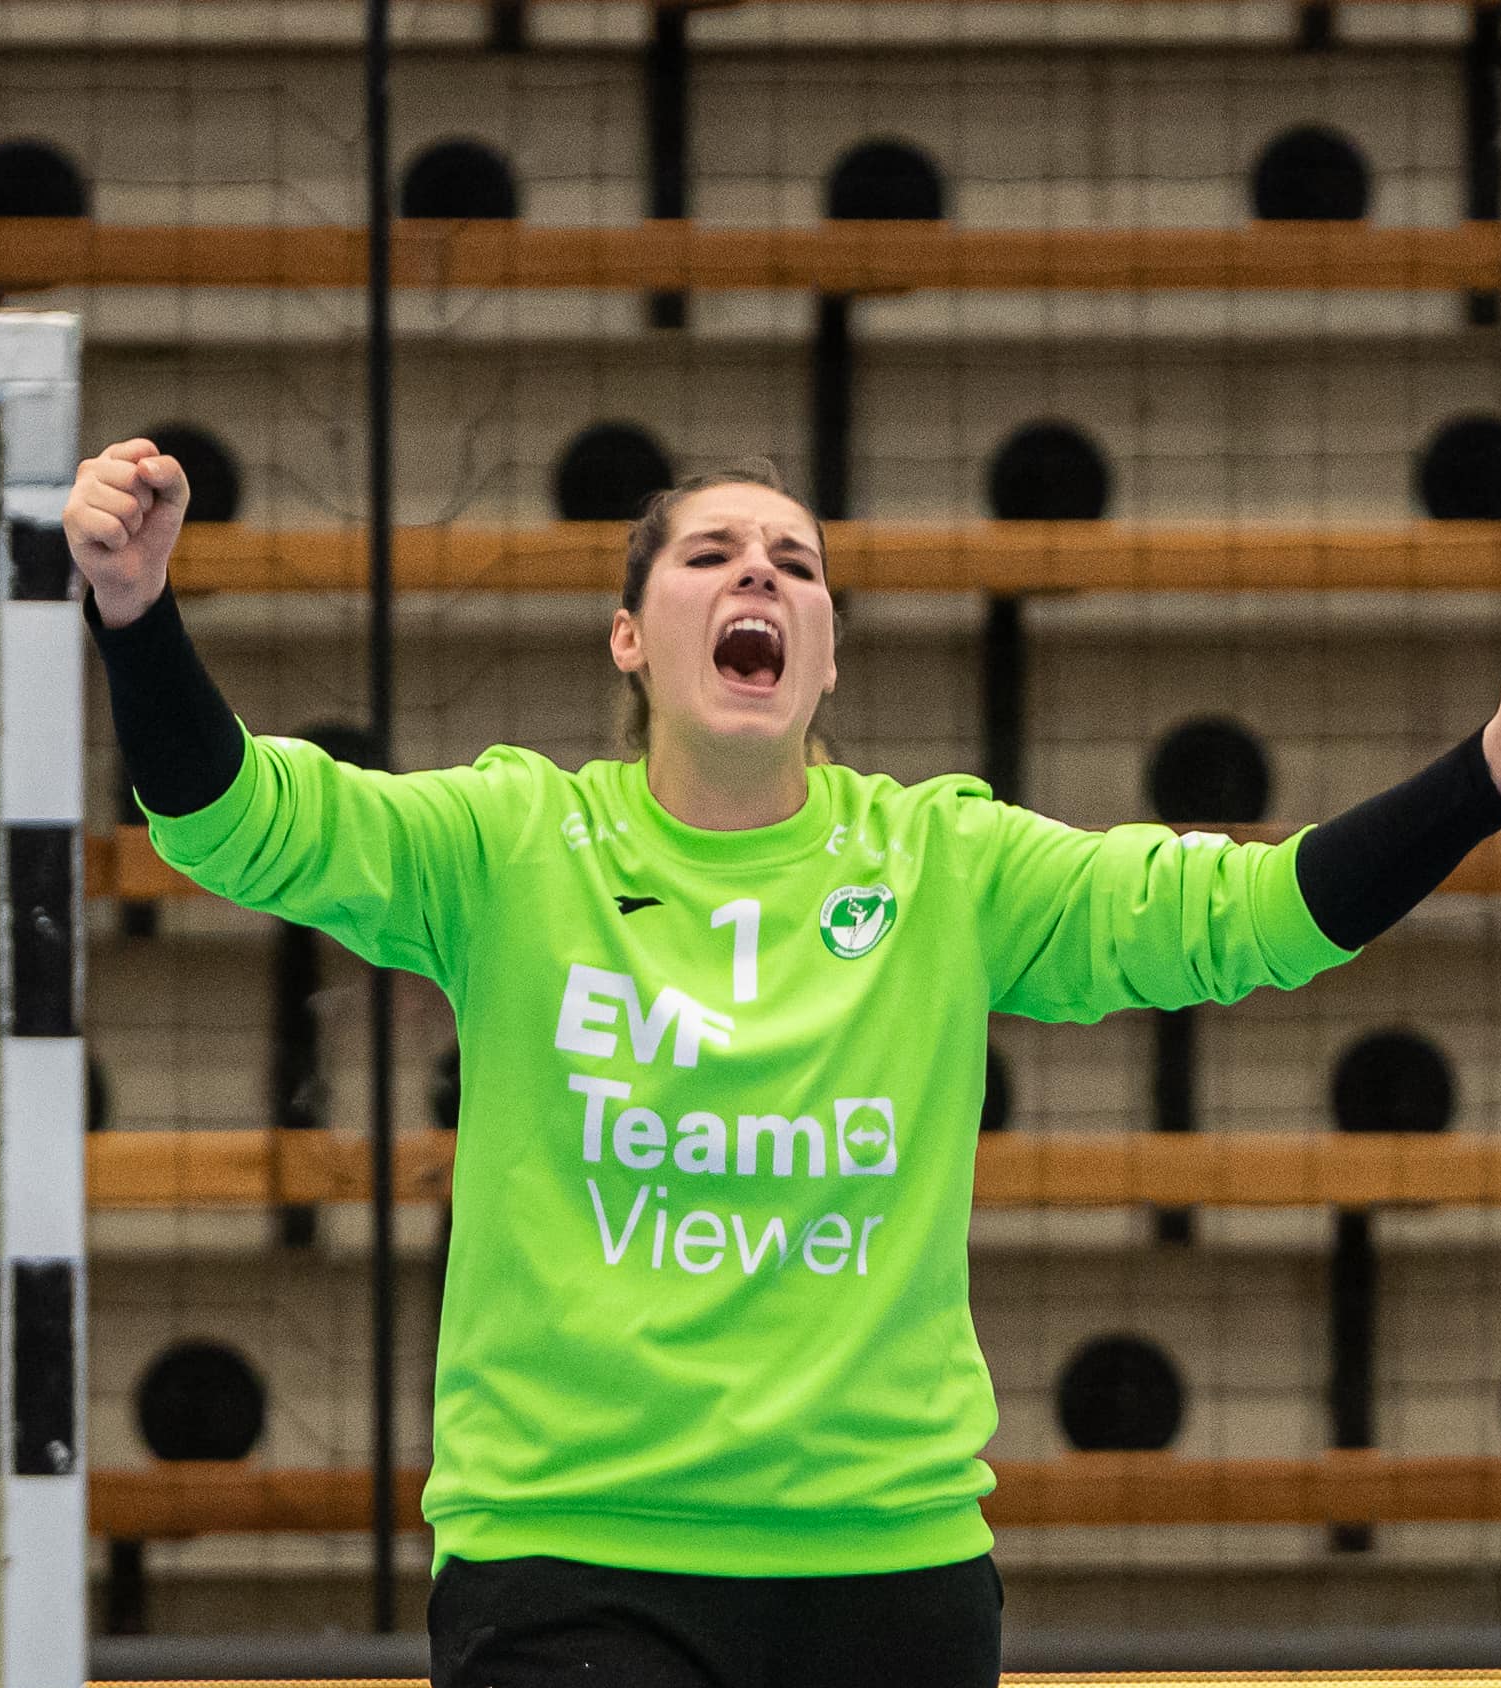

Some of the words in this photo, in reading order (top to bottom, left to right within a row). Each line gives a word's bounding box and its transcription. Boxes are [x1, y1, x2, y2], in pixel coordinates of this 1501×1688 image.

[710, 898, 761, 1001] 1
[554, 963, 736, 1069] EVF
[568, 1074, 826, 1177] Team
[587, 1178, 884, 1276] Viewer
